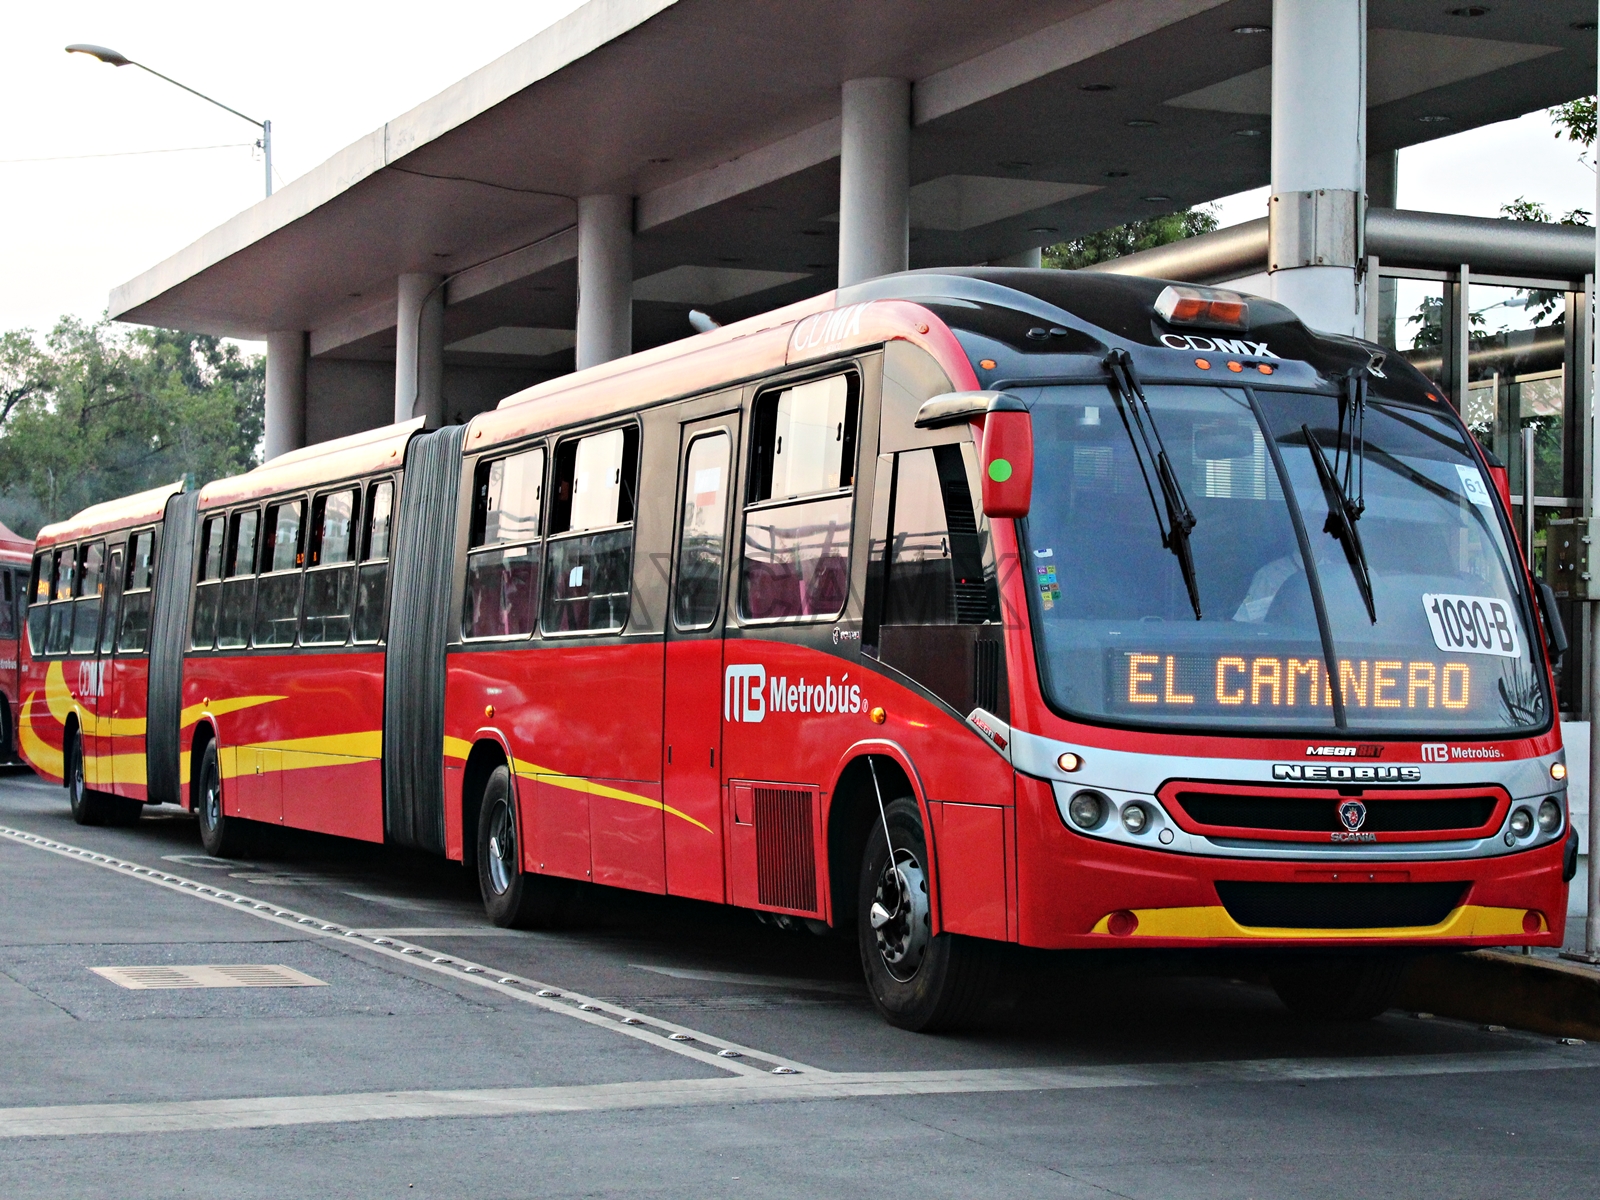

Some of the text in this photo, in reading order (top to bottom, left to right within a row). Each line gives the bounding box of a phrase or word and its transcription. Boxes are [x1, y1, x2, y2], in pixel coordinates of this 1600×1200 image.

[794, 300, 876, 351] CDMX
[1160, 334, 1281, 359] CDMX
[1431, 598, 1514, 652] 1090-B
[770, 672, 861, 713] Metrobús
[1129, 655, 1194, 703] EL
[1451, 746, 1500, 758] Metrobús
[1272, 764, 1421, 781] NEOBUS
[1330, 832, 1377, 842] SCANIA
